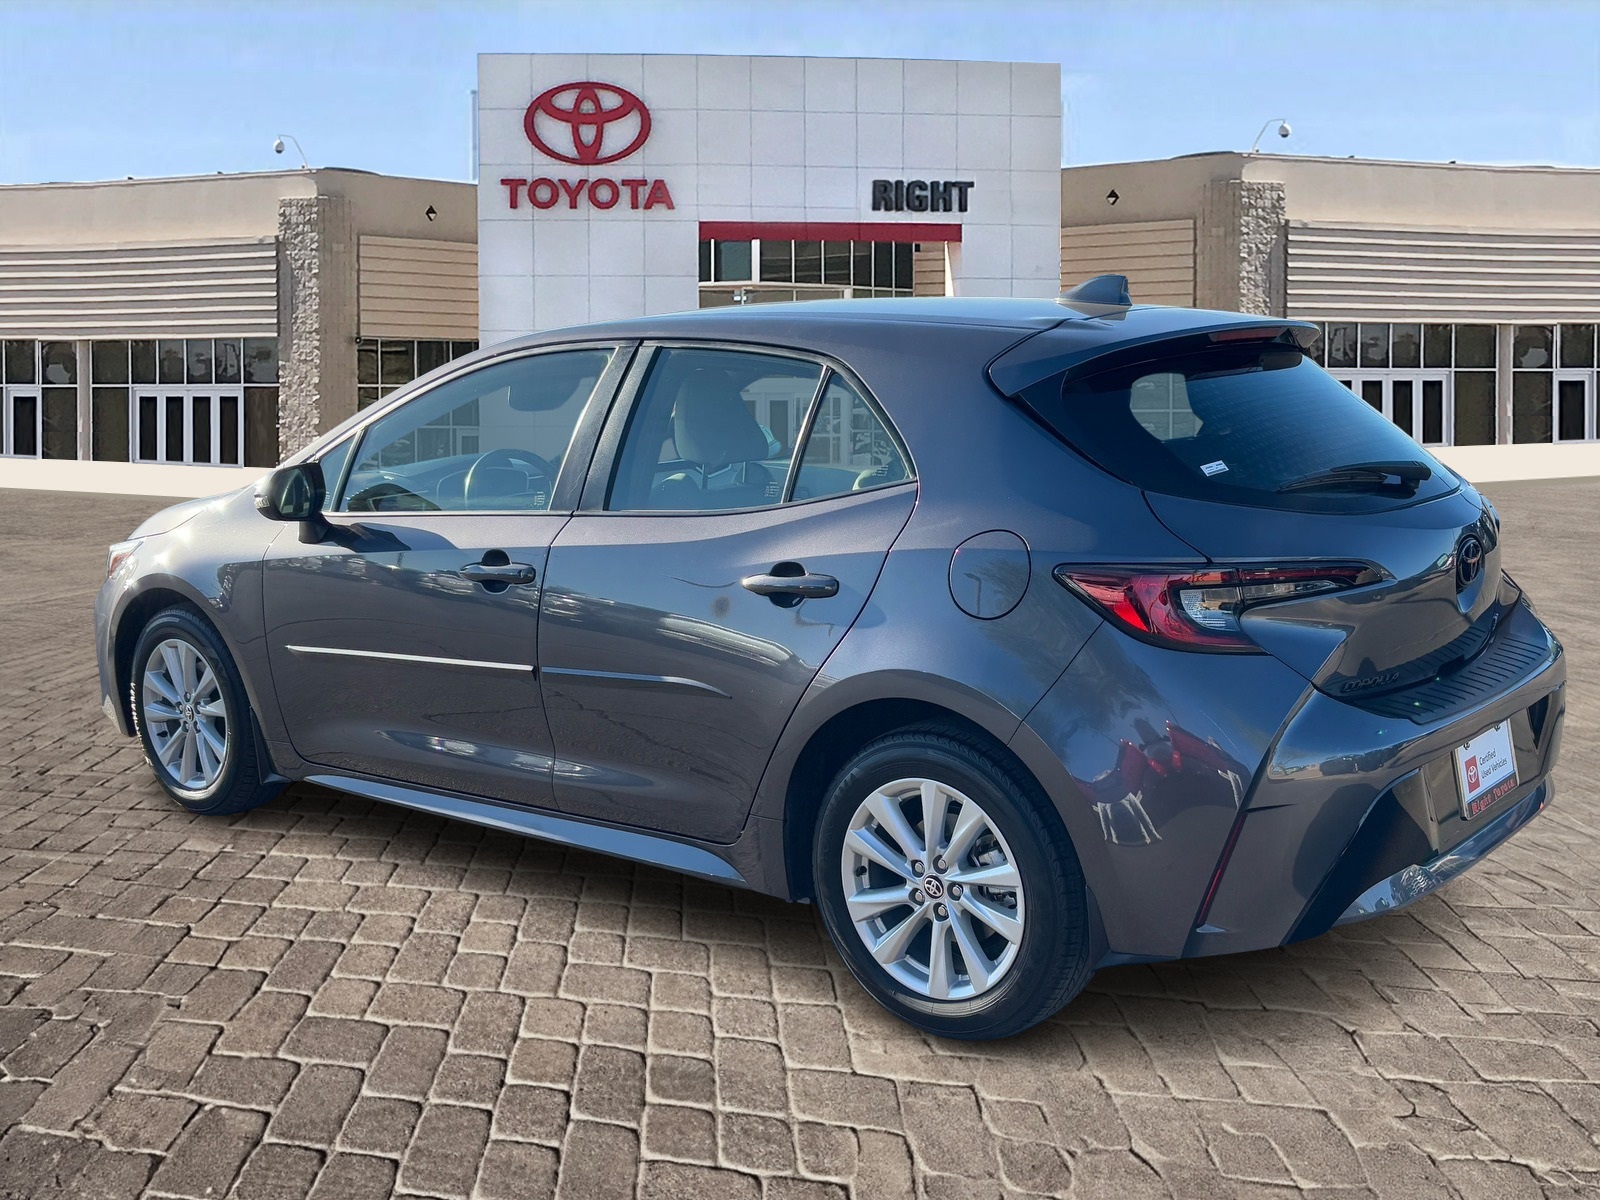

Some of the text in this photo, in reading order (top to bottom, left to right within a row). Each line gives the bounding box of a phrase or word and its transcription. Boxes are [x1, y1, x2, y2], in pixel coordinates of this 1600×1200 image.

[501, 178, 675, 211] TOYOTA
[871, 179, 975, 213] RIGHT
[1479, 748, 1496, 766] Certified
[1481, 757, 1508, 779] Used Vehicles
